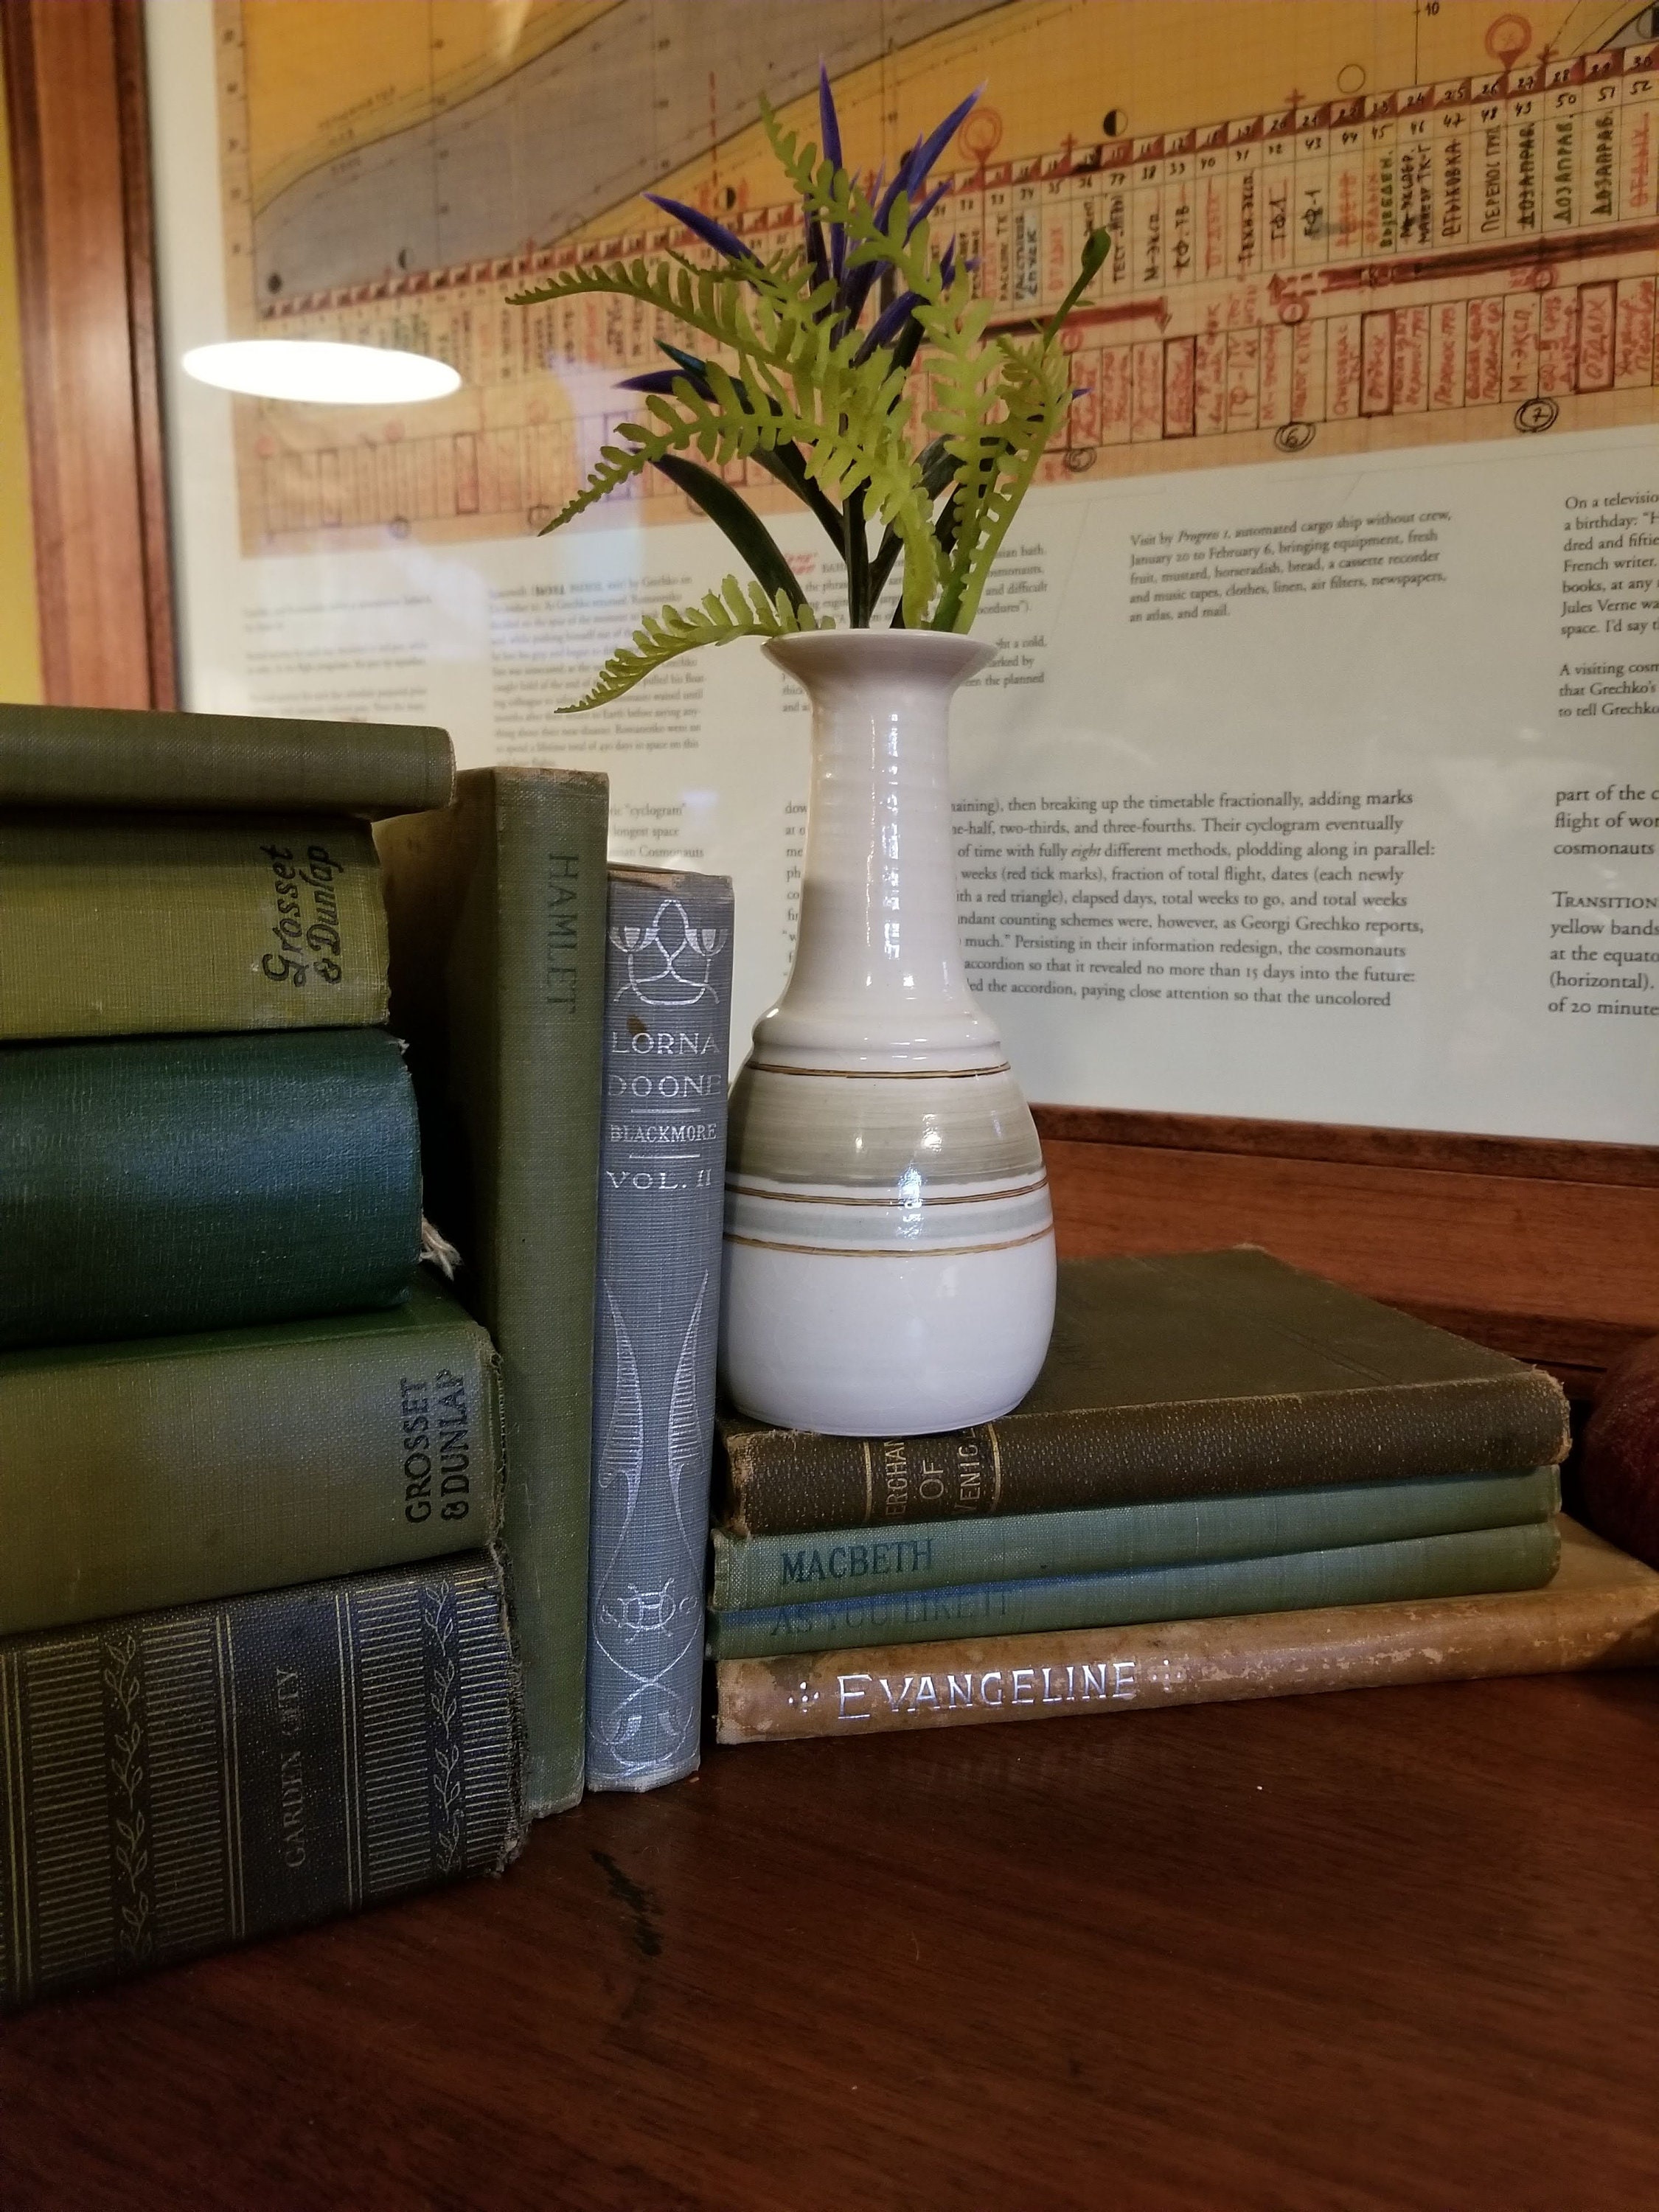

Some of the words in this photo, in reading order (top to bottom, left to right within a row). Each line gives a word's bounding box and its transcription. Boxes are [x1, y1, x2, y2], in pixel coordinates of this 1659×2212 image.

[1556, 92, 1577, 108] 50
[1597, 86, 1615, 102] 51
[1630, 80, 1653, 95] 52
[1565, 496, 1587, 509] On
[1130, 554, 1172, 568] January
[1208, 546, 1261, 560] February
[1279, 539, 1330, 556] bringing
[1408, 529, 1438, 543] fresh
[1564, 536, 1593, 552] dred
[1599, 534, 1623, 549] and
[1564, 557, 1608, 573] French
[1610, 581, 1623, 591] at
[1628, 580, 1652, 593] any
[1562, 600, 1593, 617] Jules
[1597, 599, 1637, 612] Verne
[1627, 622, 1648, 635] say
[985, 674, 1001, 686] the
[1004, 672, 1045, 688] planned
[1559, 664, 1571, 676] A
[1575, 662, 1624, 678] visiting
[1559, 684, 1585, 697] that
[1590, 680, 1656, 696] Grechko's
[1559, 708, 1572, 717] to
[1576, 703, 1597, 717] tell
[1601, 701, 1659, 716] Grechko
[1008, 797, 1036, 811] then
[1041, 796, 1097, 815] breaking
[1102, 800, 1119, 814] up
[1123, 795, 1144, 809] the
[1149, 793, 1214, 809] timetable
[1219, 792, 1303, 811] fractionally,
[1309, 790, 1361, 810] adding
[1366, 790, 1413, 806] marks
[1557, 790, 1590, 807] part
[1596, 785, 1615, 801] of
[1618, 785, 1646, 801] the
[1554, 812, 1600, 833] flight
[1605, 812, 1625, 828] of
[653, 828, 680, 842] space
[958, 843, 972, 858] of
[974, 845, 1002, 858] time
[1006, 844, 1034, 858] with
[1039, 842, 1068, 860] fully
[1071, 843, 1102, 862] eight
[1105, 842, 1161, 858] different
[1167, 841, 1231, 858] methods,
[1237, 841, 1302, 861] plodding
[1307, 841, 1349, 861] along
[1353, 841, 1368, 856] in
[1374, 841, 1435, 861] parallel:
[1554, 844, 1655, 855] cosmonauts
[961, 866, 997, 880] weeks
[1001, 866, 1026, 881] (red
[1031, 866, 1054, 880] tick
[1058, 866, 1107, 882] marks),
[1112, 866, 1164, 880] fraction
[1169, 866, 1185, 880] of
[1188, 866, 1218, 880] total
[1224, 866, 1265, 886] flight,
[1271, 866, 1308, 881] dates
[1314, 866, 1352, 883] (each
[1358, 866, 1404, 886] newly
[260, 845, 310, 988] Grosset
[1000, 913, 1057, 931] counting
[1060, 912, 1113, 928] schemes
[1158, 914, 1217, 930] however,
[1223, 919, 1236, 928] as
[1241, 915, 1290, 935] Georgi
[1295, 916, 1360, 932] Grechko
[1366, 922, 1423, 936] reports,
[546, 853, 580, 1015] HAMLET
[1551, 918, 1604, 939] yellow
[1550, 950, 1565, 960] at
[1571, 945, 1598, 961] the
[964, 956, 1024, 971] accordion
[1029, 961, 1042, 971] so
[1046, 958, 1071, 973] that
[1077, 959, 1084, 973] it
[1090, 960, 1141, 975] revealed
[1147, 965, 1164, 975] no
[1169, 966, 1205, 976] more
[1210, 961, 1240, 977] than
[1263, 964, 1295, 983] days
[1301, 966, 1329, 981] into
[1335, 965, 1359, 981] the
[1550, 970, 1654, 992] (horizontal).
[988, 978, 1007, 992] the
[1011, 981, 1077, 996] accordion,
[1082, 983, 1125, 1001] paying
[1129, 984, 1161, 998] close
[1166, 986, 1228, 1001] attention
[1234, 992, 1248, 1001] so
[1253, 987, 1281, 1003] that
[1287, 989, 1310, 1004] the
[1315, 991, 1391, 1006] uncolored
[1548, 997, 1568, 1012] of
[1571, 1002, 1591, 1013] 20
[611, 1032, 721, 1055] LORNA
[608, 1074, 722, 1097] DOONE
[610, 1123, 717, 1143] BLACKMORE
[606, 1170, 687, 1191] VOL.
[400, 1377, 431, 1523] GROSSET
[919, 1459, 945, 1500] OF
[779, 1537, 934, 1586] MACBETH
